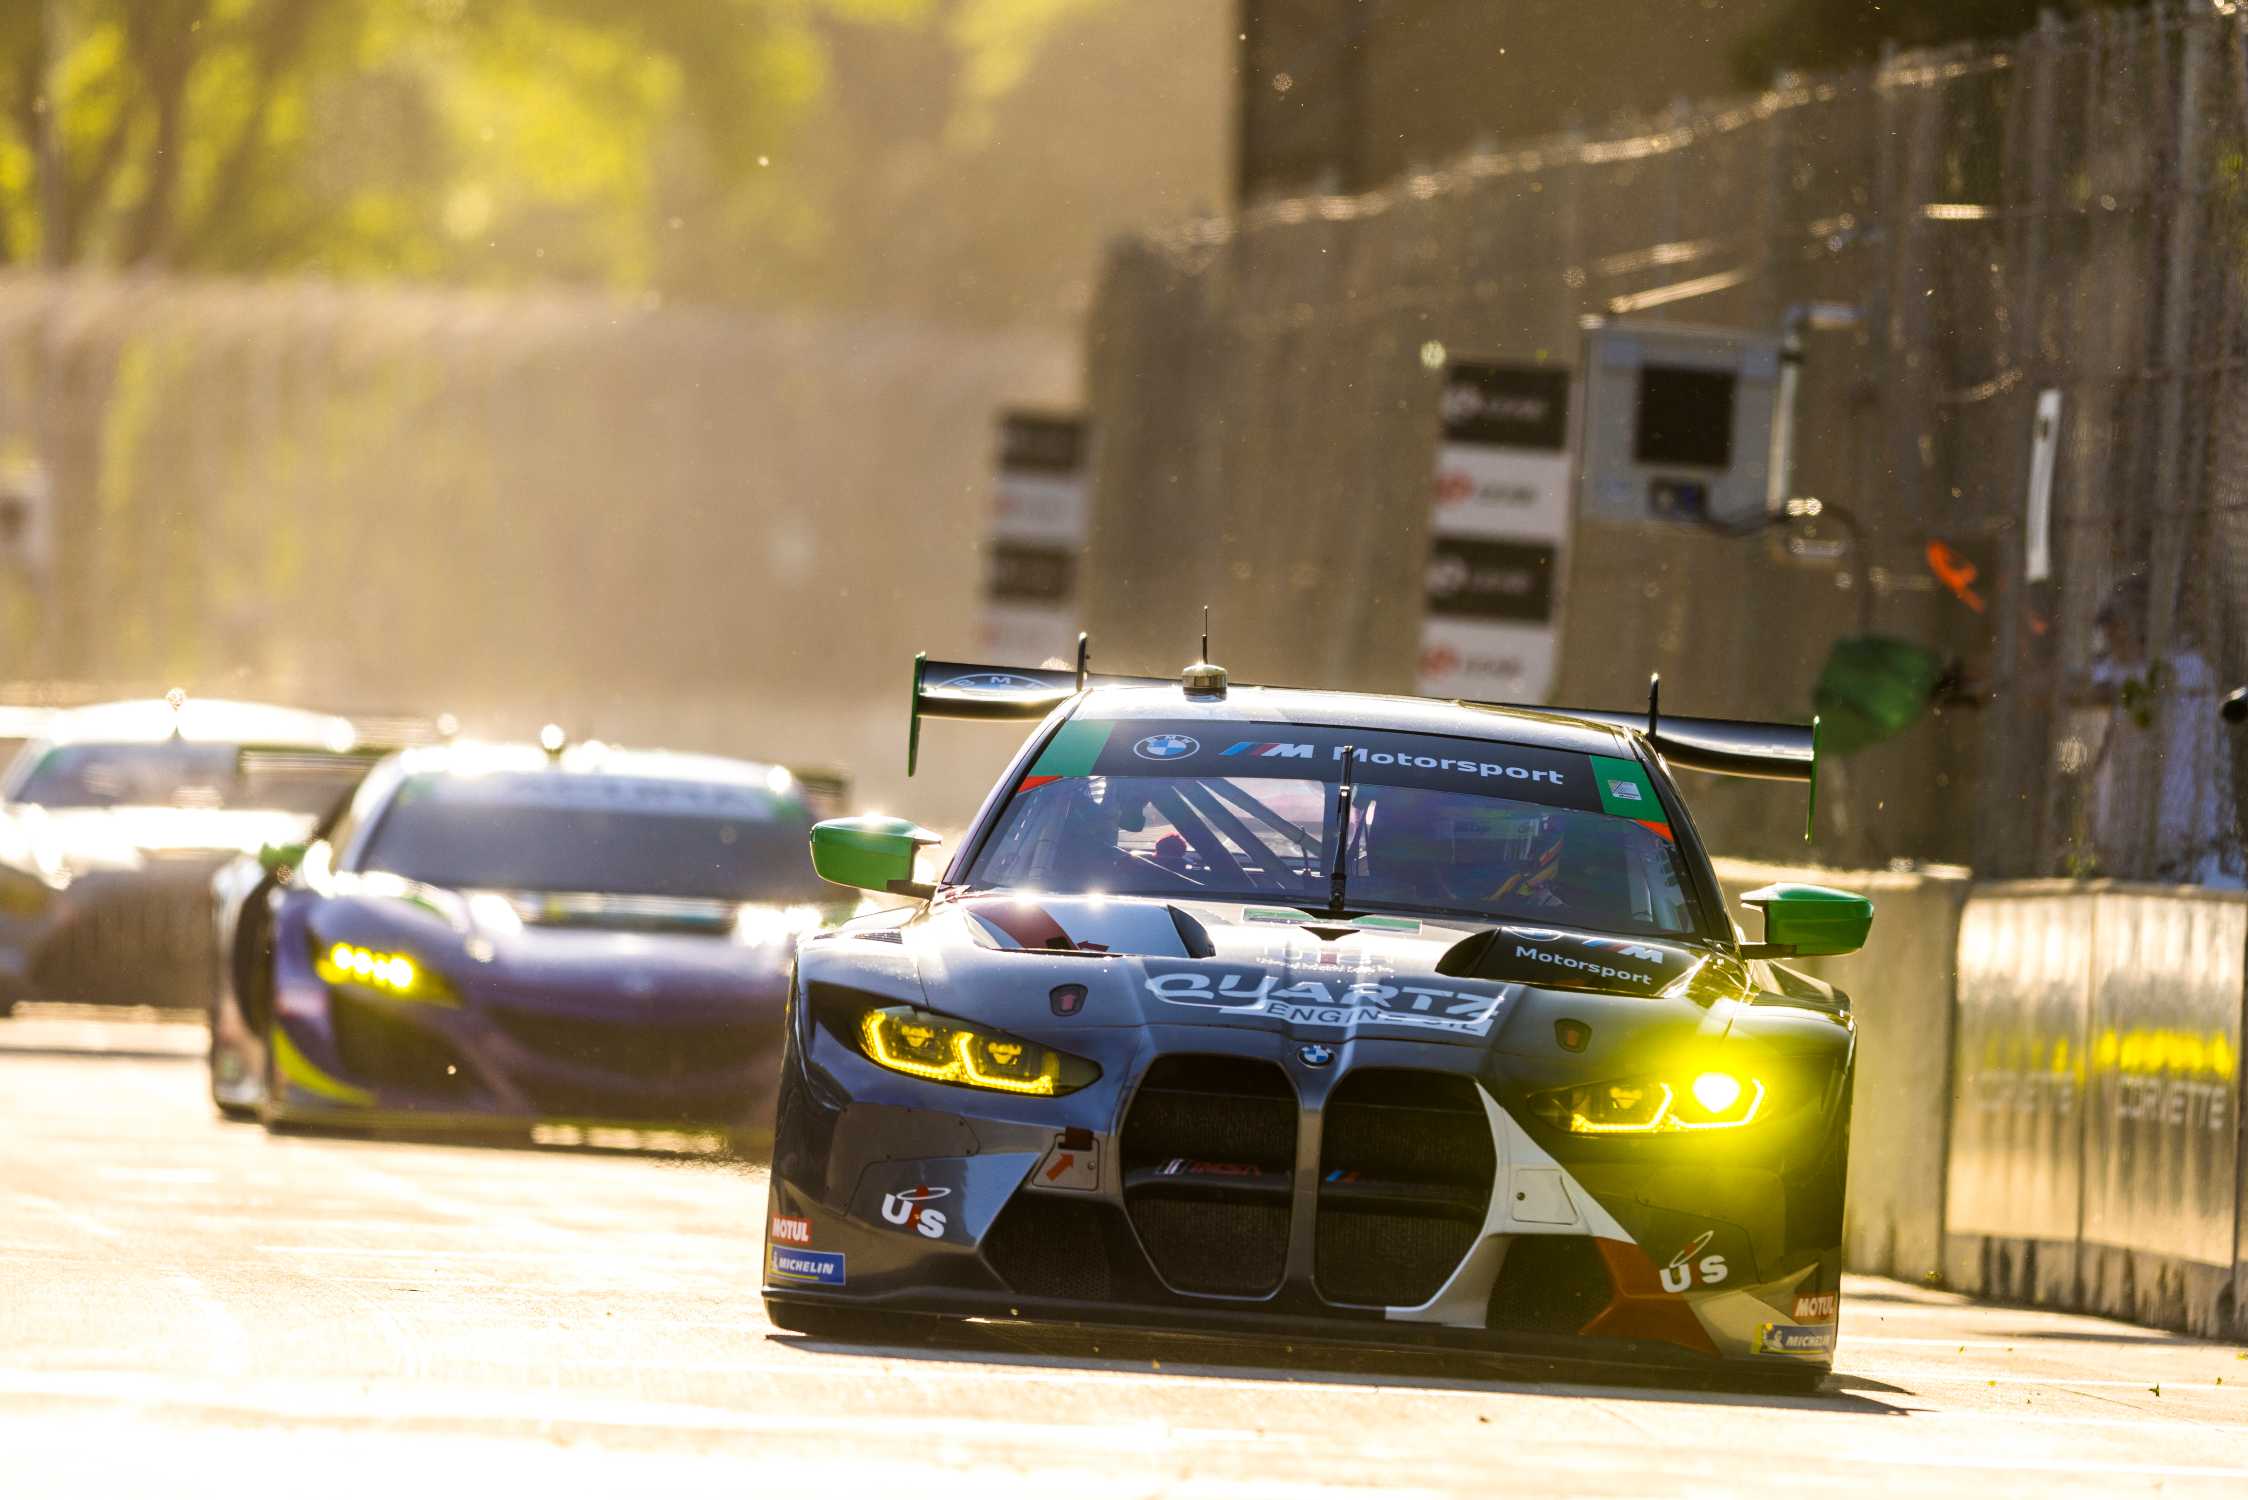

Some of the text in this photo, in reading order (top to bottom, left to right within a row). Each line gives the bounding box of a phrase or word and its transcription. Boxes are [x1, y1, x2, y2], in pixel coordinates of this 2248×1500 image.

[1333, 745, 1564, 785] Motorsport
[1515, 946, 1652, 985] Motorsport
[1145, 973, 1500, 1018] QUARTZ
[772, 1217, 809, 1242] MOTUL
[779, 1257, 834, 1275] MICHELIN
[1794, 1296, 1834, 1317] MOTUL
